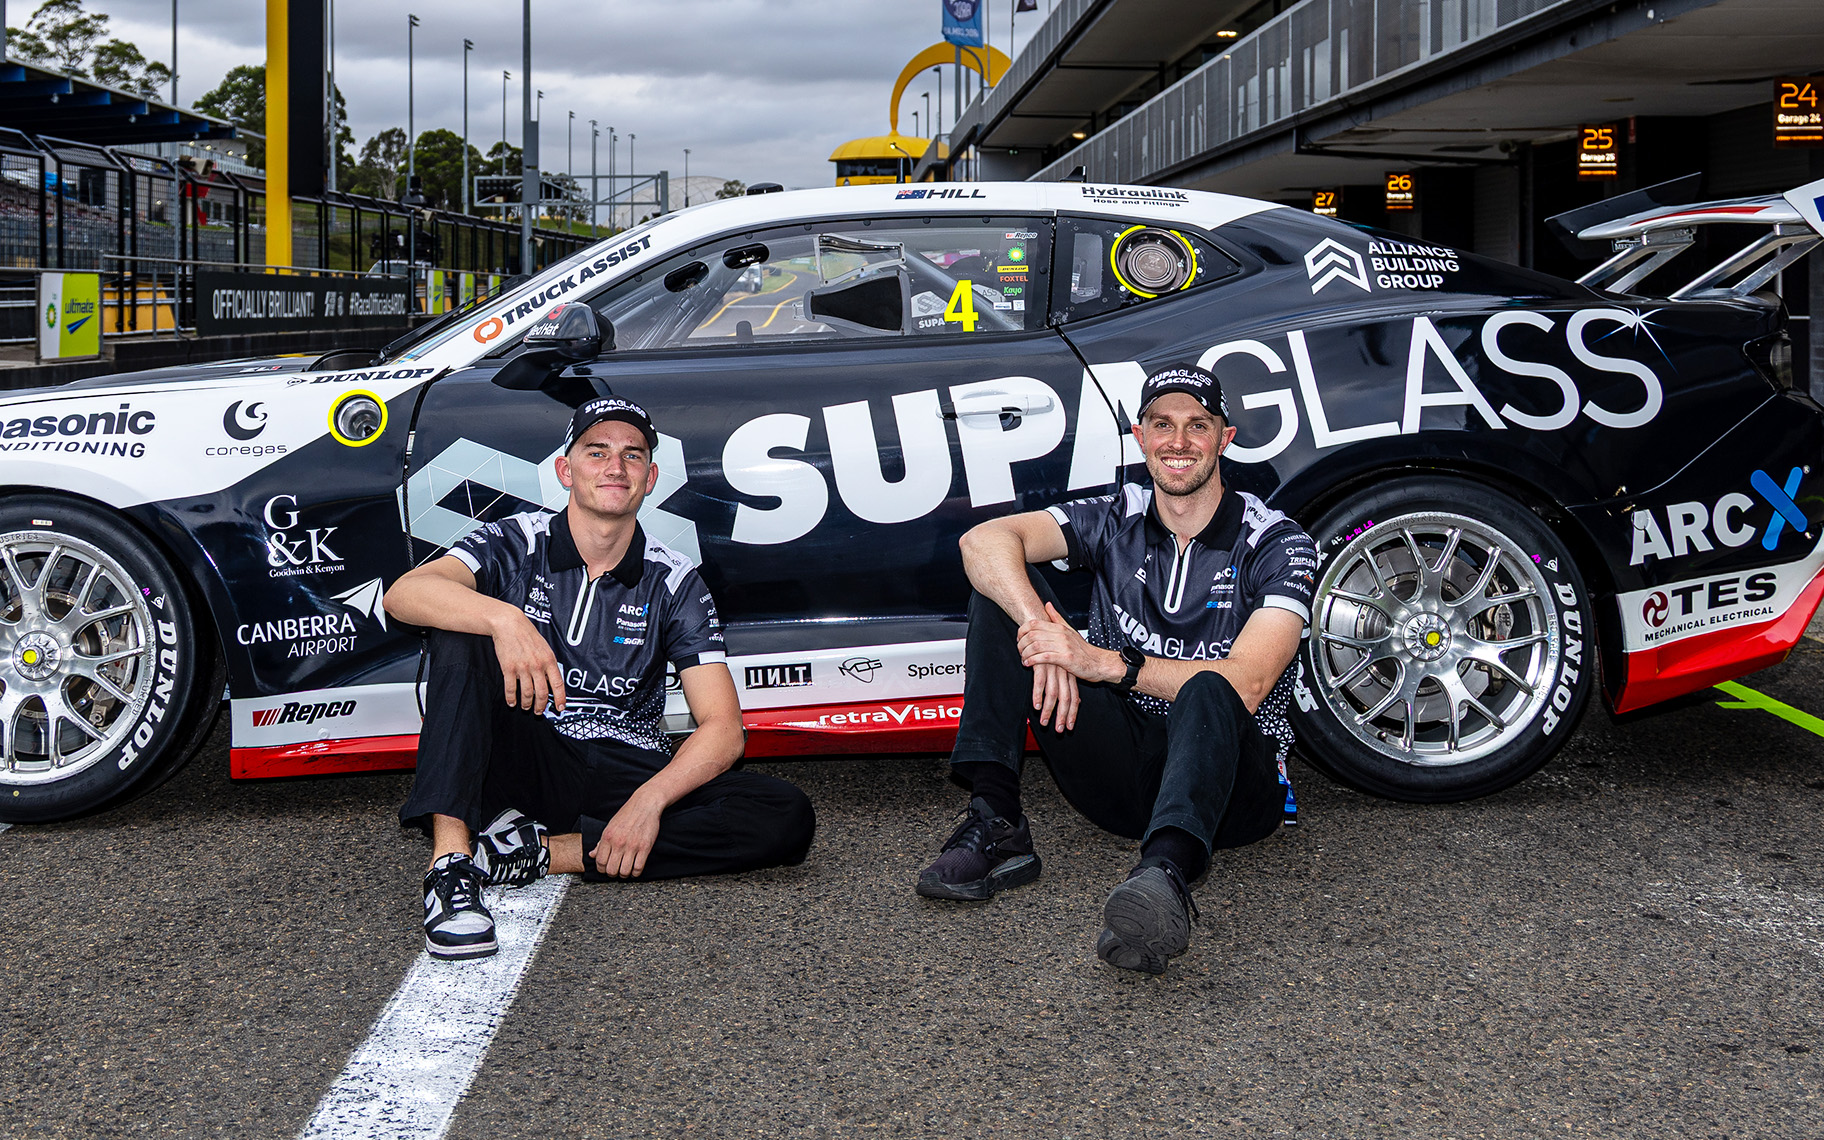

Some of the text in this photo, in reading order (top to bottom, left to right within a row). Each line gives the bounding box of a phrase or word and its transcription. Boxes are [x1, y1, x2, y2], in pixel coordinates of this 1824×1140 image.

[1780, 83, 1818, 108] 24
[1777, 113, 1808, 125] Garage
[1582, 128, 1613, 150] 25
[1081, 186, 1188, 199] Hydraulink
[1387, 174, 1412, 191] 26
[927, 188, 986, 198] HILL
[1315, 191, 1335, 207] 27
[1368, 241, 1459, 259] ALLIANCE
[1371, 257, 1460, 273] BUILDING
[501, 234, 652, 326] TRUCK ASSIST
[1376, 274, 1444, 289] GROUP
[1003, 286, 1023, 297] Kayo
[64, 298, 94, 314] ultimate
[212, 289, 268, 319] OFFICIALLY
[268, 290, 315, 318] BRILLIANT!
[944, 280, 979, 332] 4
[310, 367, 435, 385] DUNLOP
[1148, 369, 1213, 387] SUPAGLASS
[1156, 377, 1203, 388] RACING
[0, 403, 156, 439] asonic
[720, 308, 1665, 546] SUPAGLASS
[205, 444, 288, 456] coregas
[264, 494, 300, 530] G
[269, 563, 345, 578] Goodwin & Kenyon
[1671, 572, 1777, 615] TES
[524, 604, 552, 619] DAF
[236, 612, 357, 645] CANBERRA
[616, 618, 648, 628] Panasoni
[1644, 606, 1774, 642] MECHANICAL ELECTRICAL
[286, 635, 358, 659] AIRPORT
[1541, 582, 1583, 736] DUNLOP
[557, 661, 642, 698] GLASS
[117, 619, 178, 771] DUNLOP
[277, 700, 357, 725] Repco
[819, 704, 964, 726] retraVisio
